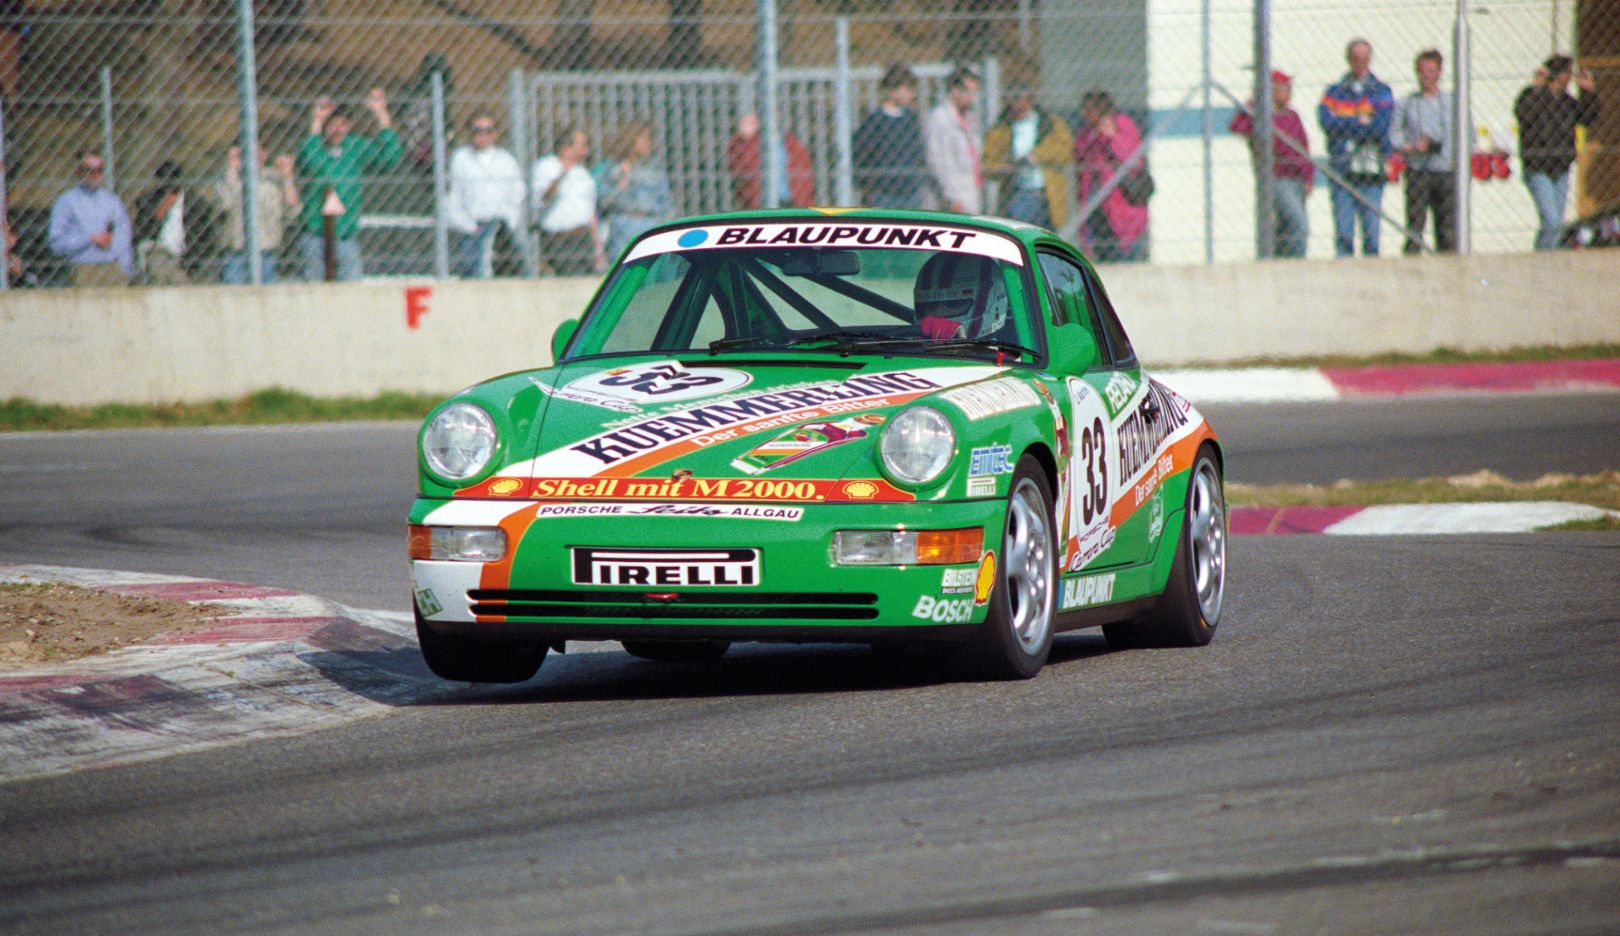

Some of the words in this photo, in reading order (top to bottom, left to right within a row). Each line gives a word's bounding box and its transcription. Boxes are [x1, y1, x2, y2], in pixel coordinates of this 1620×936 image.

[716, 226, 976, 250] BLAUPUNKT
[404, 287, 433, 329] F
[571, 372, 945, 465] KUEMMERLING
[690, 429, 739, 450] Der
[742, 408, 822, 433] sanfte
[824, 398, 892, 415] Bitter
[533, 479, 618, 497] Shell
[623, 479, 684, 497] mit
[1081, 416, 1108, 526] 33
[540, 505, 623, 515] PORSCHE
[573, 549, 756, 585] PIRELLI
[912, 595, 974, 623] BOSCH
[1062, 574, 1115, 609] BLAUPUNKT
